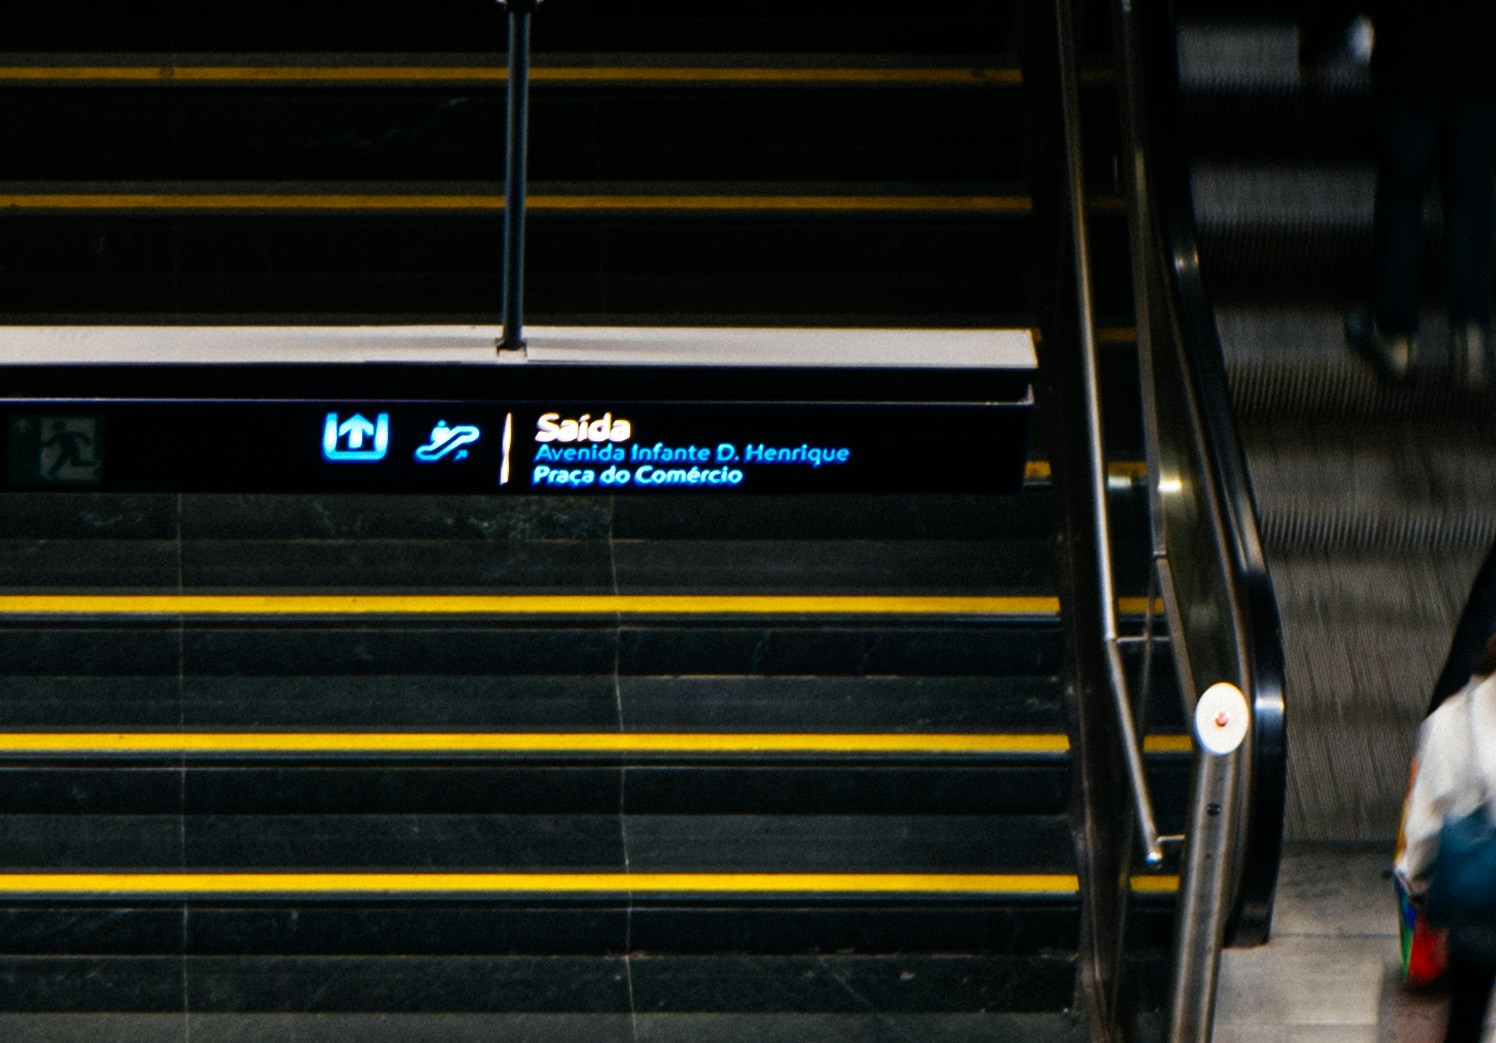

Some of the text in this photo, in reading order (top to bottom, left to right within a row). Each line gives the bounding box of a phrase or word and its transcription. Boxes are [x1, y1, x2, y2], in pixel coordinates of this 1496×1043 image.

[534, 411, 632, 443] Saída
[533, 441, 851, 467] Avenida Infante D. Henrique
[532, 464, 745, 487] Praça do Comércio
